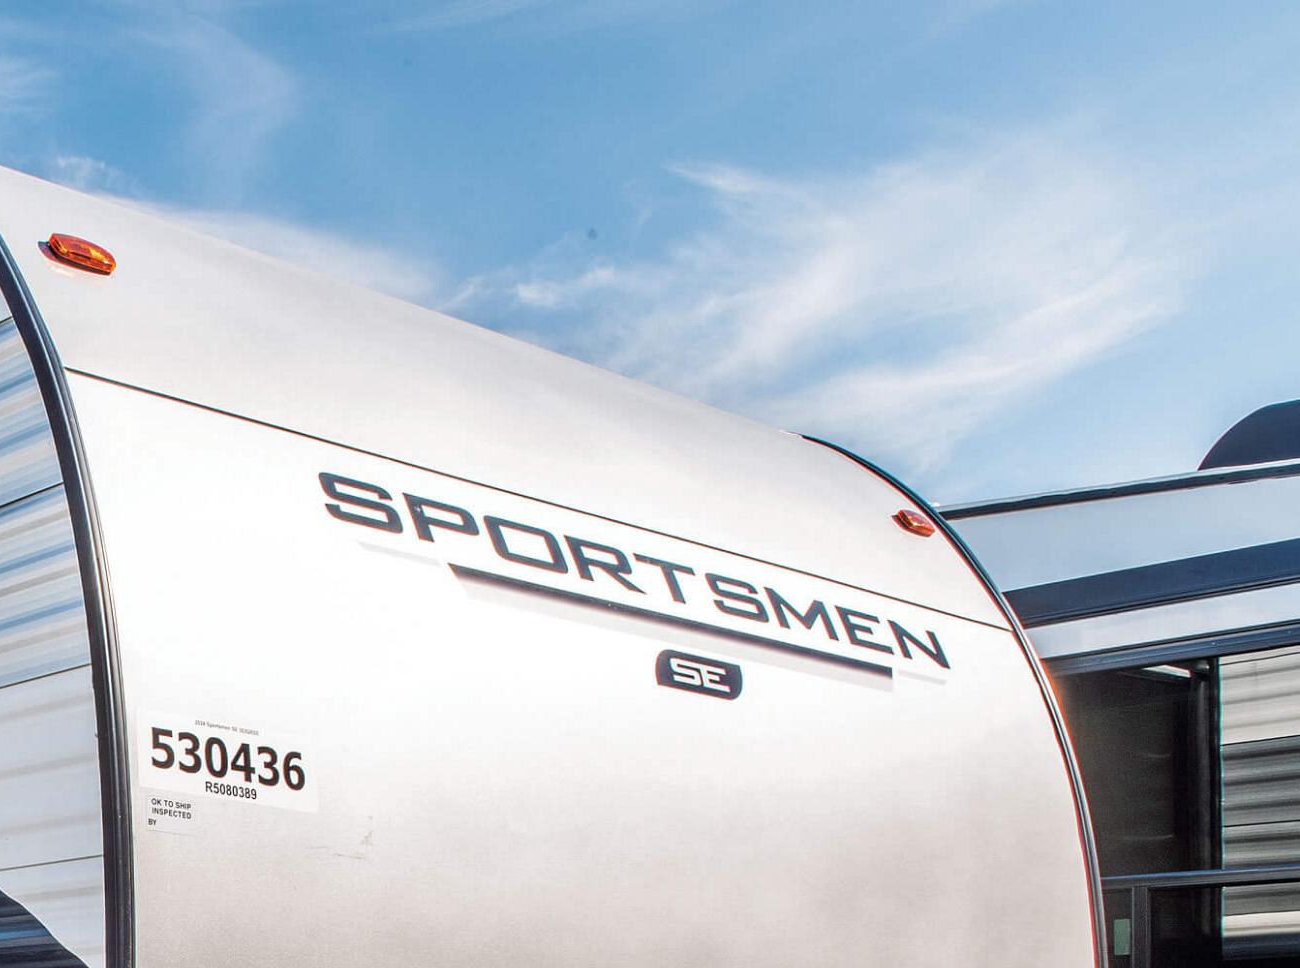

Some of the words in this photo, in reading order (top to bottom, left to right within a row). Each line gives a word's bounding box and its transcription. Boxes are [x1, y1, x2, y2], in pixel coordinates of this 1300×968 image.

[318, 472, 951, 670] SPORTSMEN
[669, 658, 728, 692] SE
[150, 727, 305, 791] 530436
[205, 781, 257, 800] R5080389
[151, 798, 162, 806] OK
[164, 800, 174, 808] TO
[175, 802, 192, 810] SHIP
[151, 807, 192, 819] INSPECTED
[148, 818, 157, 826] BY
